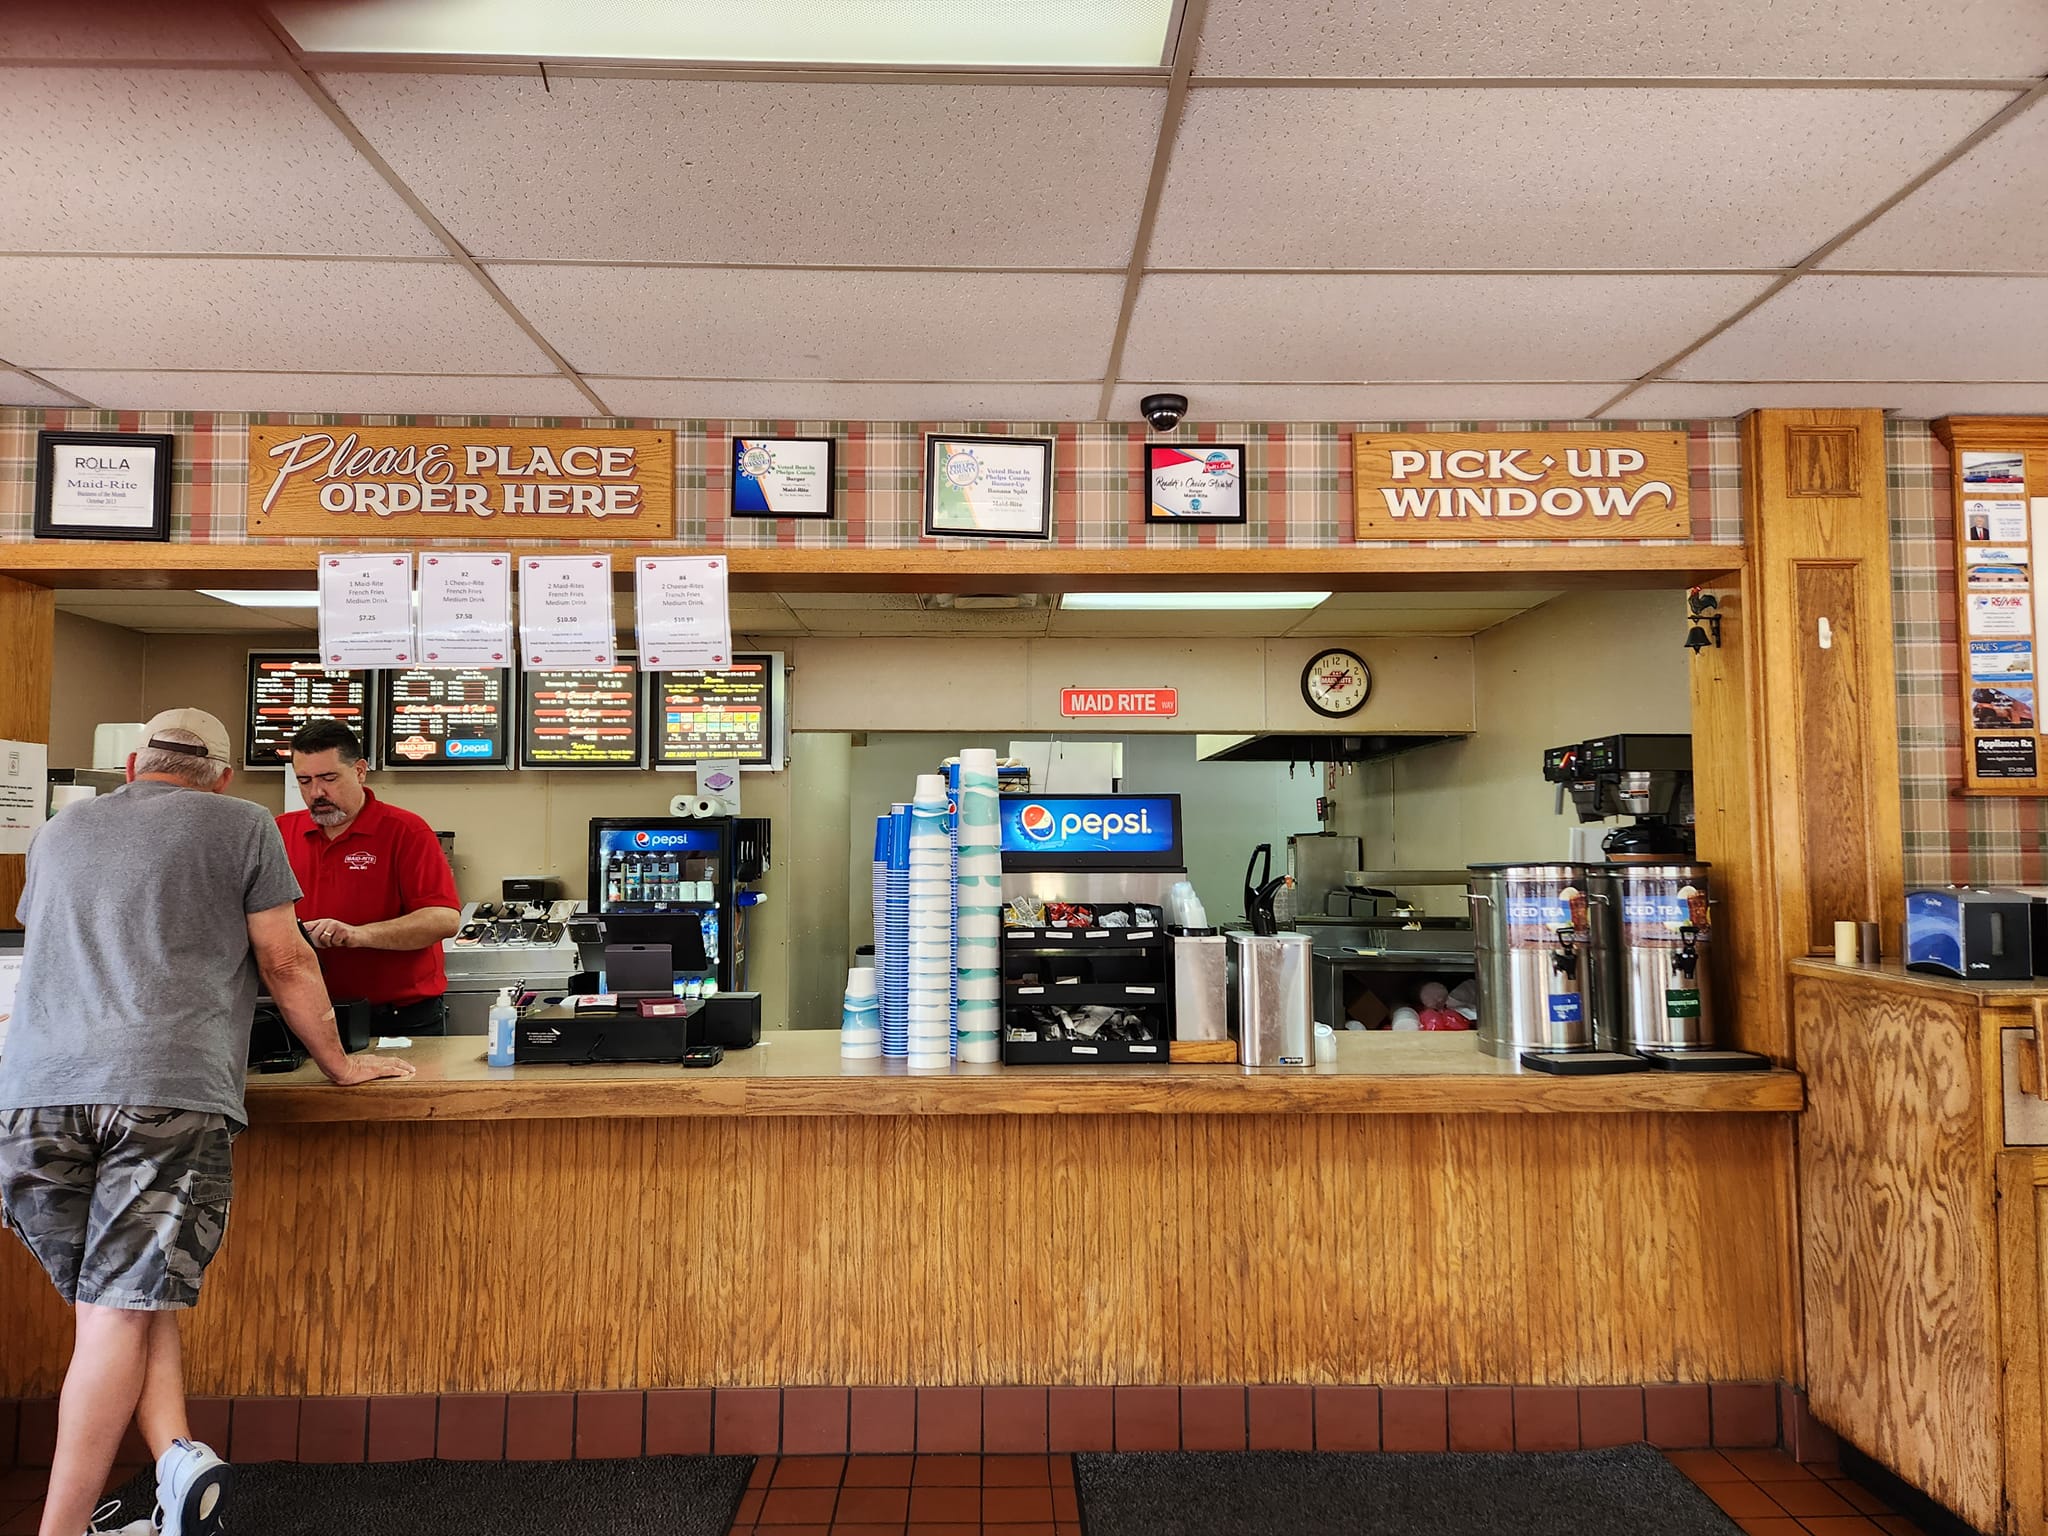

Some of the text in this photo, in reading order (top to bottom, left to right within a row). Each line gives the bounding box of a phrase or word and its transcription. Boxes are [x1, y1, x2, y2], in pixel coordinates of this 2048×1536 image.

[75, 457, 130, 470] ROLLA
[464, 446, 636, 477] PLACE
[1008, 474, 1031, 482] County
[67, 479, 138, 490] Maid-Rite
[319, 483, 642, 517] ORDER HERE
[1377, 480, 1673, 517] WINDOW
[1322, 660, 1329, 668] 11
[1332, 657, 1340, 665] 12
[1354, 667, 1359, 675] 2
[1357, 678, 1362, 686] 3
[1071, 694, 1174, 711] MAID RITE WAY
[1335, 700, 1339, 708] 6
[1346, 697, 1351, 705] 5
[462, 744, 489, 753] pepsi
[1978, 739, 2033, 750] Appliance Rx
[652, 833, 688, 847] pepsi
[1509, 907, 1565, 917] ICED TEA
[1625, 905, 1683, 916] ICED TEA
